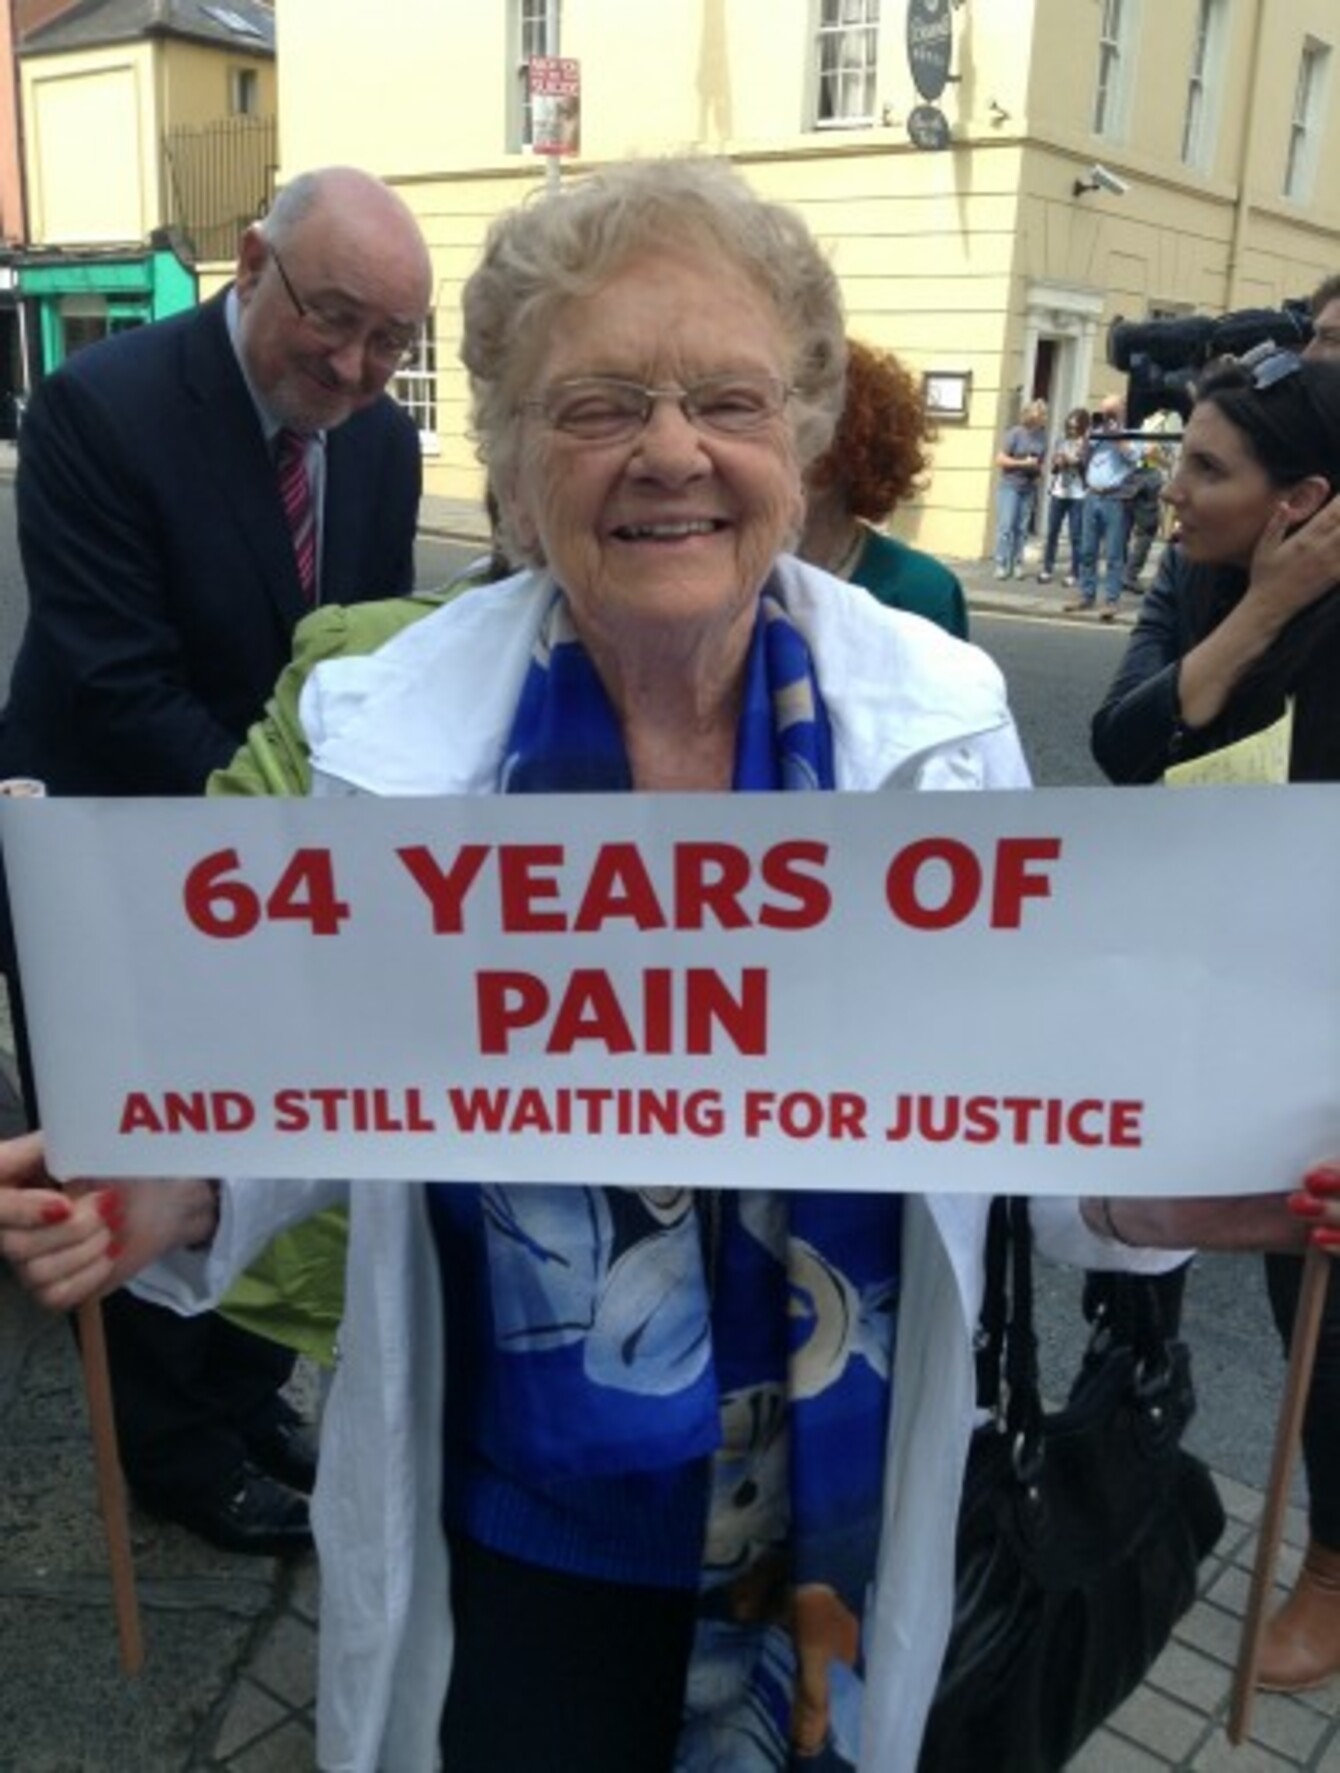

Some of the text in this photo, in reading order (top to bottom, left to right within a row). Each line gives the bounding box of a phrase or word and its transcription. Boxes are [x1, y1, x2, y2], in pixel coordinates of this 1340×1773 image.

[183, 836, 1062, 938] 64 YEARS OF
[475, 968, 769, 1055] PAIN
[120, 1087, 1144, 1148] AND STILL WAITING FOR JUSTICE
